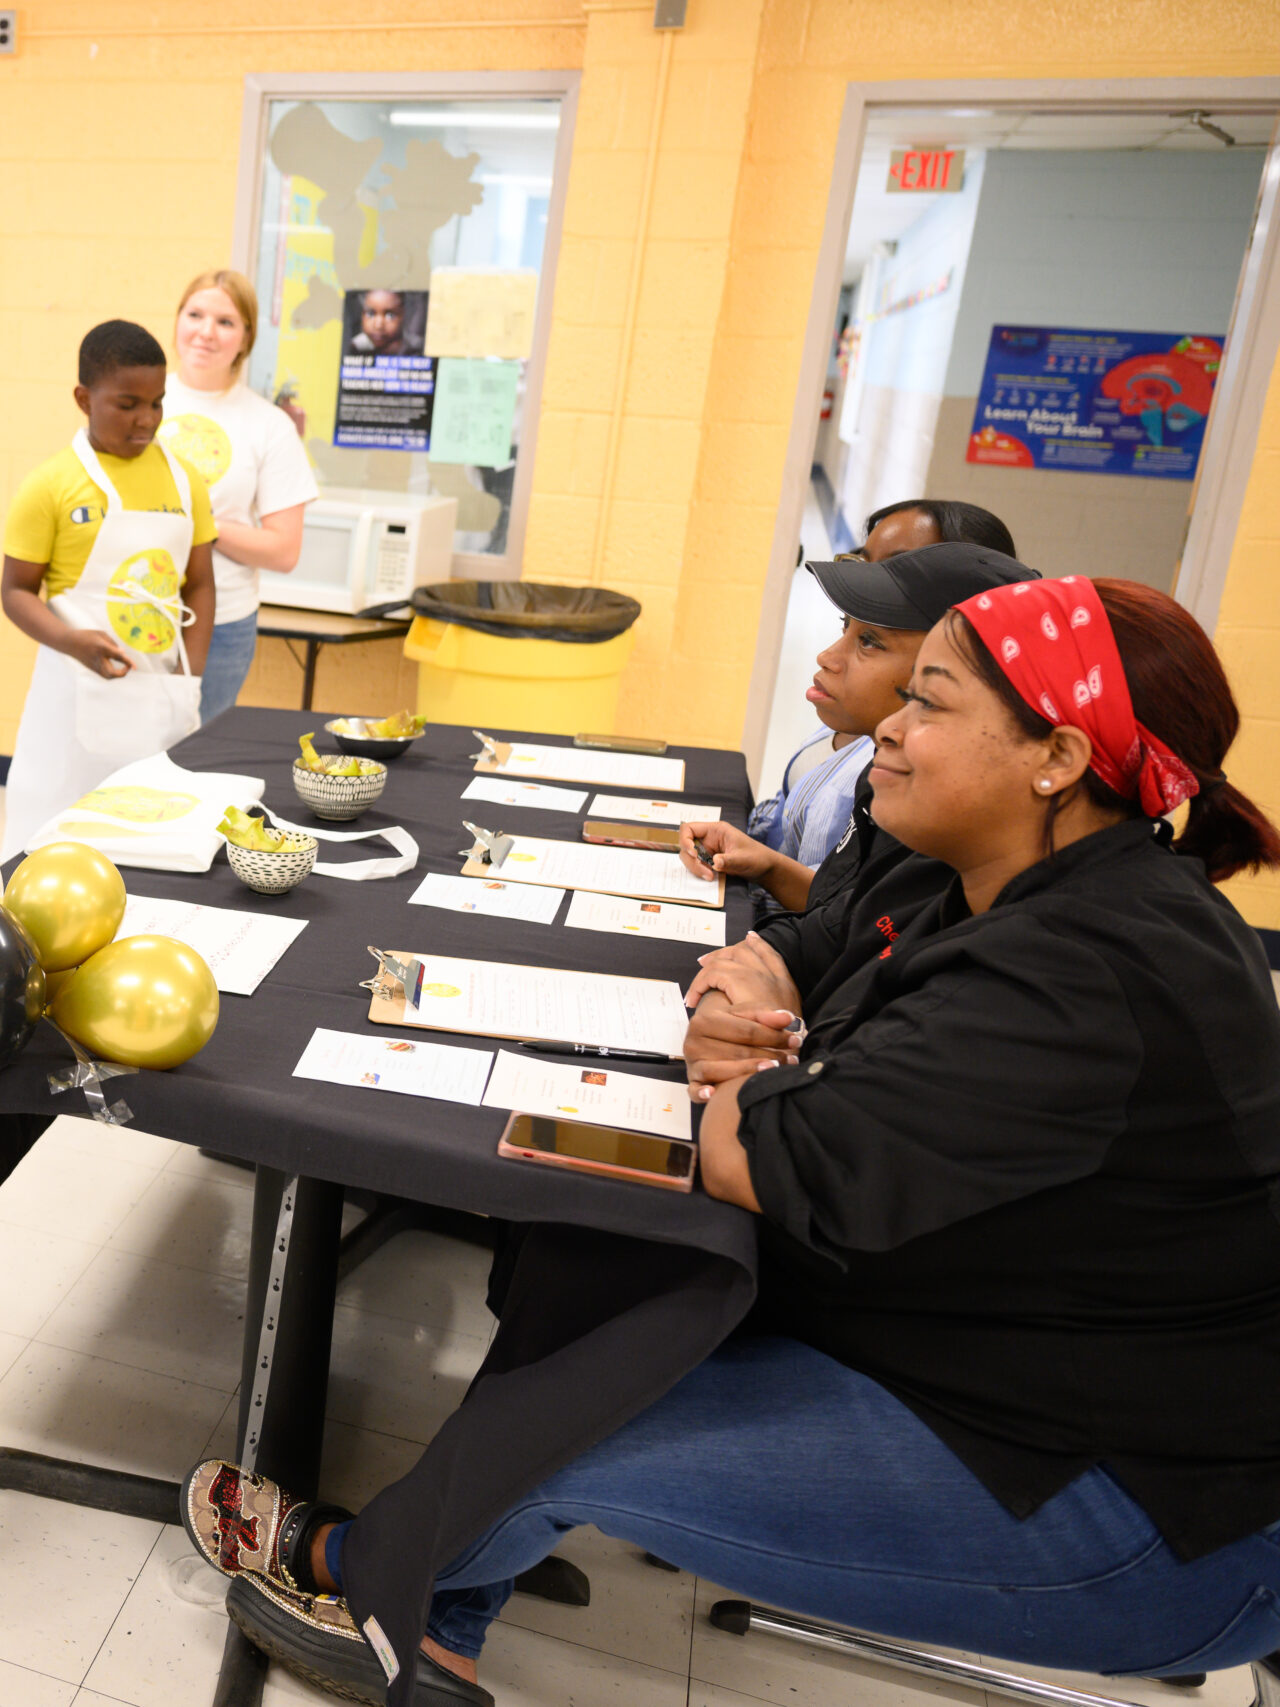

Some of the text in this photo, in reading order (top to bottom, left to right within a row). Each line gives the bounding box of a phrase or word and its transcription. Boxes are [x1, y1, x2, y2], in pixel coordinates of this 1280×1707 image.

[900, 151, 955, 189] EXIT
[984, 404, 1078, 424] Learn About
[1027, 420, 1104, 438] Your Brain
[876, 915, 900, 942] Che
